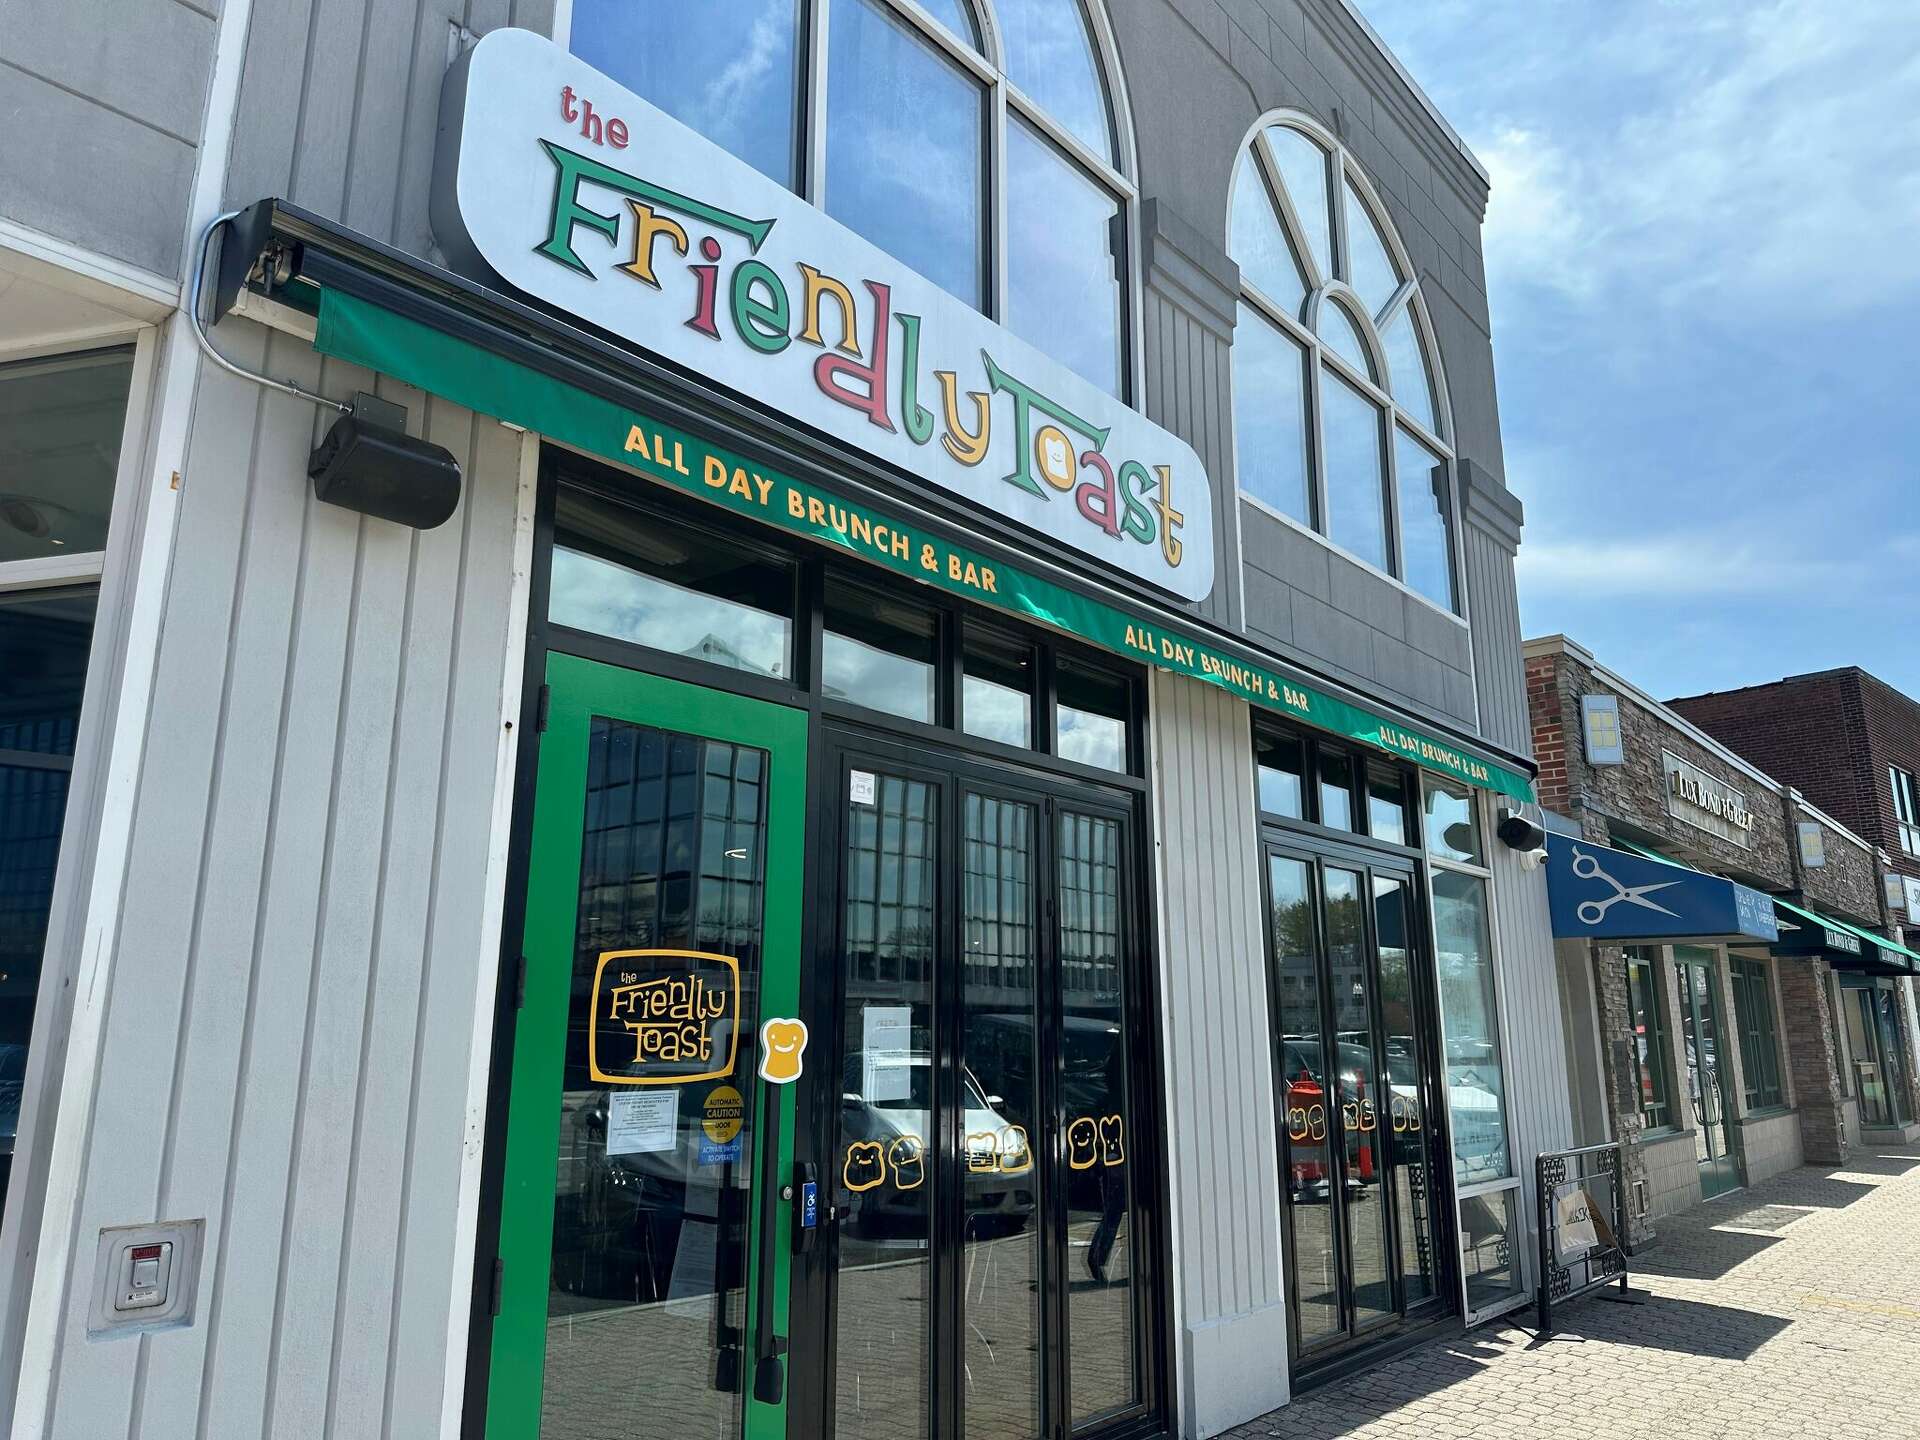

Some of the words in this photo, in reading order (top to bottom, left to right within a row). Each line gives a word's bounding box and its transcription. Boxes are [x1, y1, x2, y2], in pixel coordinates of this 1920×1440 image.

[560, 85, 629, 150] the
[532, 137, 991, 468] Friendly
[980, 347, 1184, 568] Toast
[624, 424, 690, 476] ALL
[704, 454, 775, 506] DAY
[787, 487, 910, 561] BRUNCH
[920, 543, 940, 573] &
[948, 553, 998, 593] BAR
[1124, 624, 1157, 654] ALL
[1161, 638, 1194, 668] DAY
[1200, 652, 1264, 695] BRUNCH
[1267, 680, 1279, 701] &
[1283, 685, 1310, 713] BAR
[1380, 725, 1398, 748] ALL
[1400, 732, 1420, 755] DAY
[1421, 741, 1461, 770] BRUNCH
[1462, 758, 1470, 775] &
[1470, 763, 1489, 782] BAR
[609, 974, 726, 1020] Friendly
[620, 971, 638, 985] the
[623, 1020, 712, 1063] Toast
[706, 1108, 740, 1118] CAUTION
[708, 1097, 740, 1106] AUTOMATIC
[714, 1121, 731, 1129] DOOR
